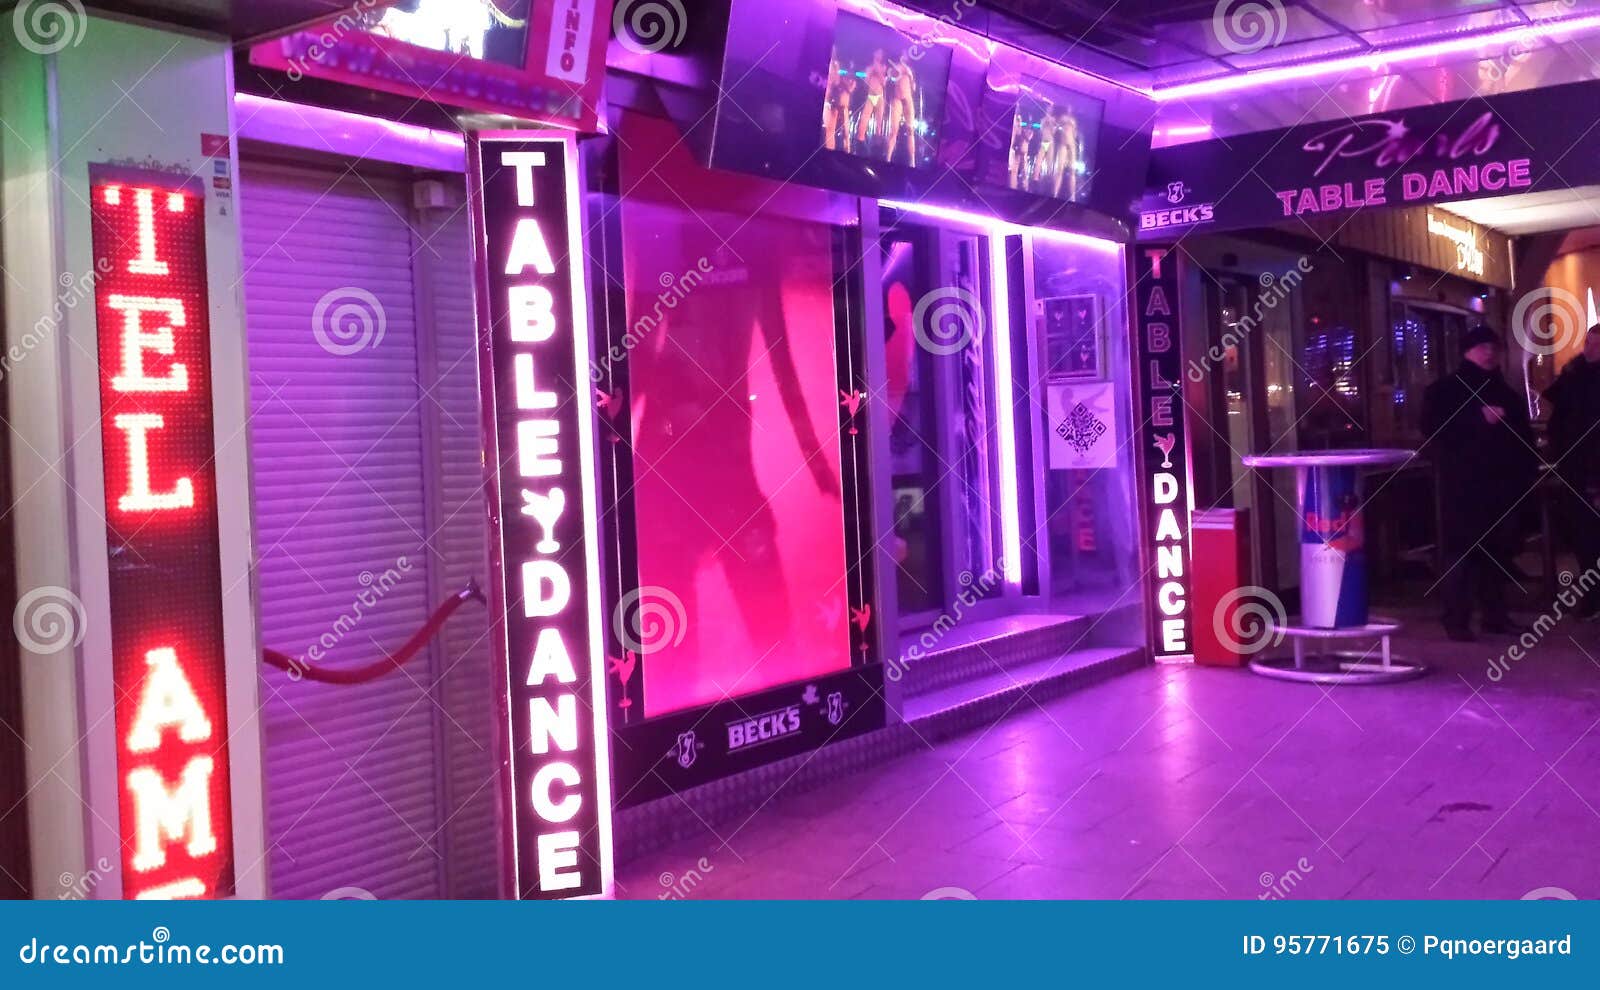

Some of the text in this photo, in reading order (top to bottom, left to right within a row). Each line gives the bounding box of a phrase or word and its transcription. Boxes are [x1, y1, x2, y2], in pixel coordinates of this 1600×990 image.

[1141, 204, 1214, 229] BECK'S
[1277, 158, 1532, 216] TABLE DANCE
[103, 184, 195, 512] TEL
[501, 151, 583, 892] TABLE DANCE
[1145, 249, 1186, 652] TABLE DANCE
[728, 706, 801, 750] BECK'S
